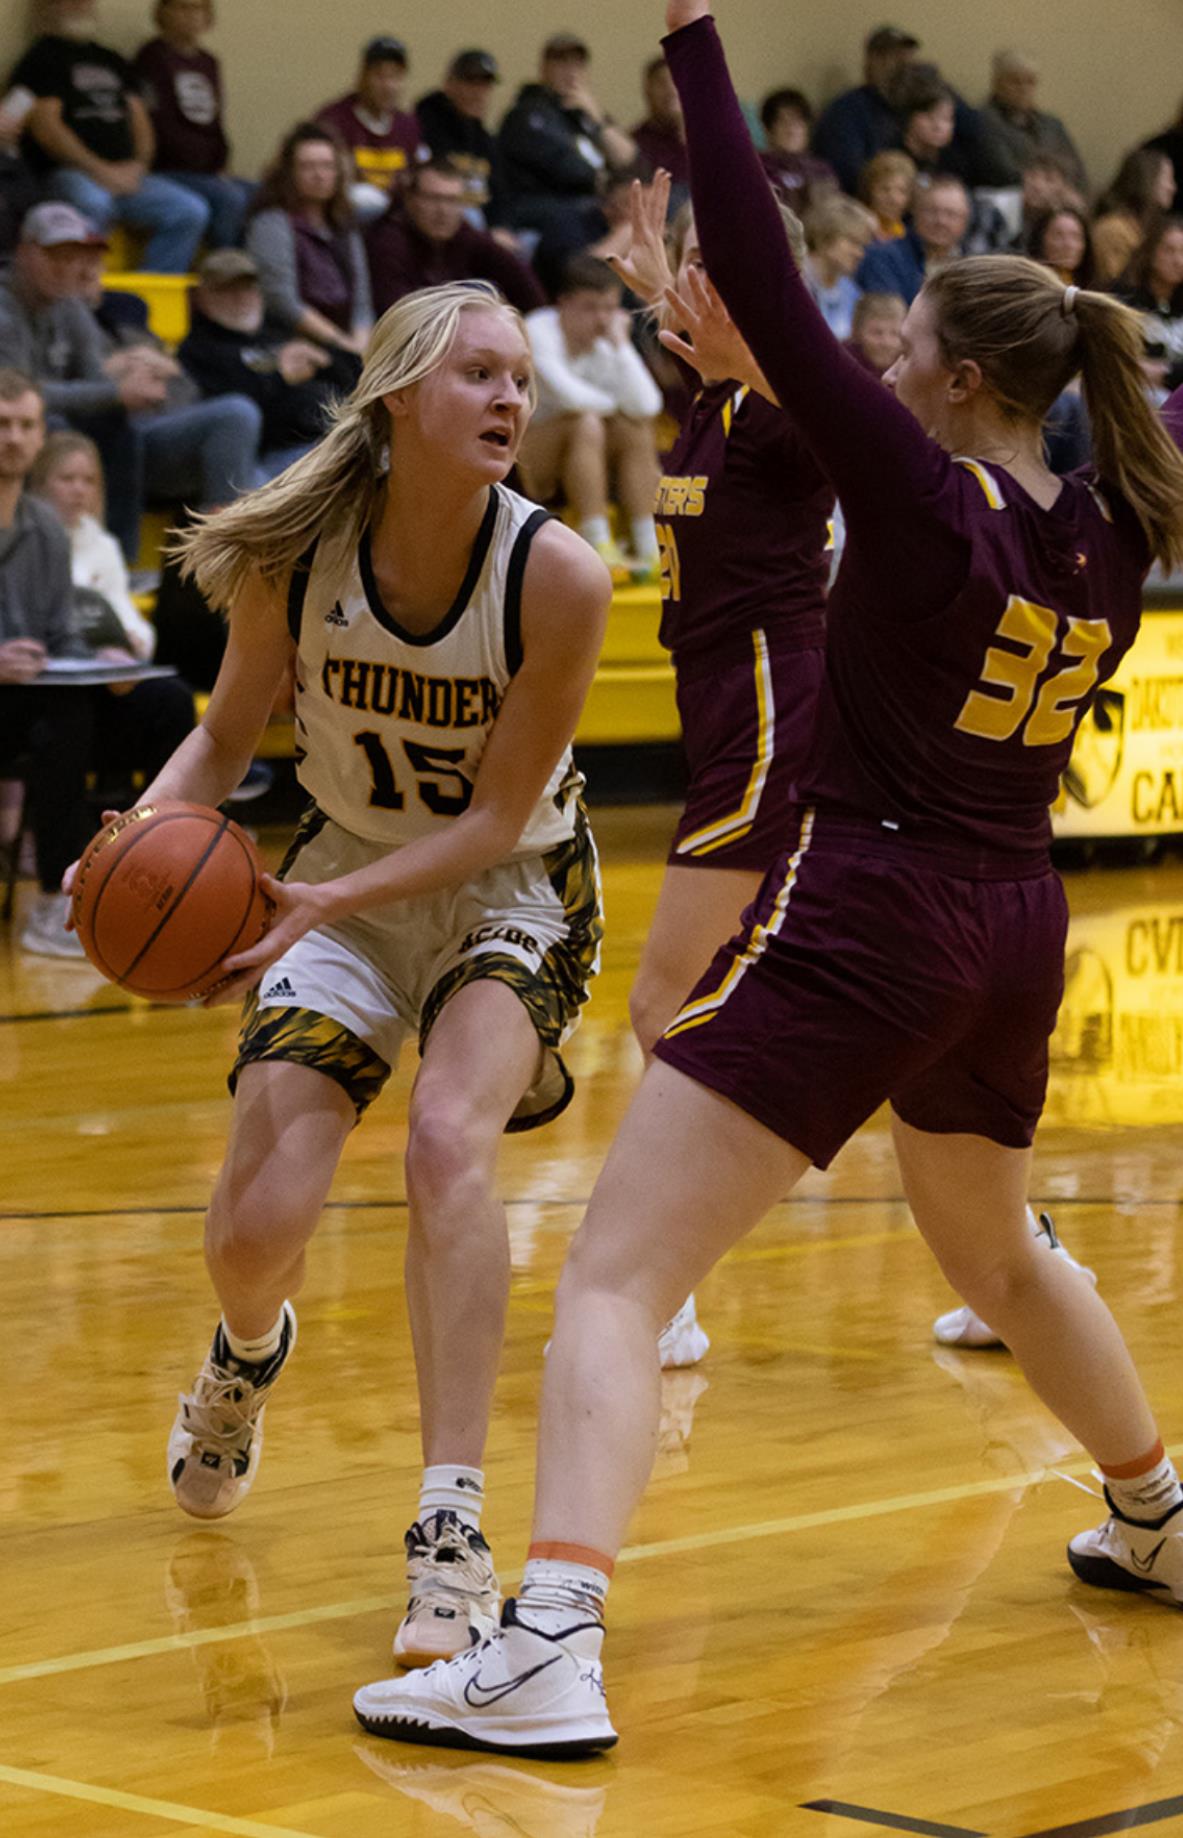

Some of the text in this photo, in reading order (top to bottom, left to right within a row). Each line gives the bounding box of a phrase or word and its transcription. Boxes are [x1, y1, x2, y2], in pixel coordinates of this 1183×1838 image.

[321, 655, 501, 730] THUNDER
[953, 594, 1112, 747] 32
[353, 730, 474, 817] 15
[1132, 771, 1183, 824] CA
